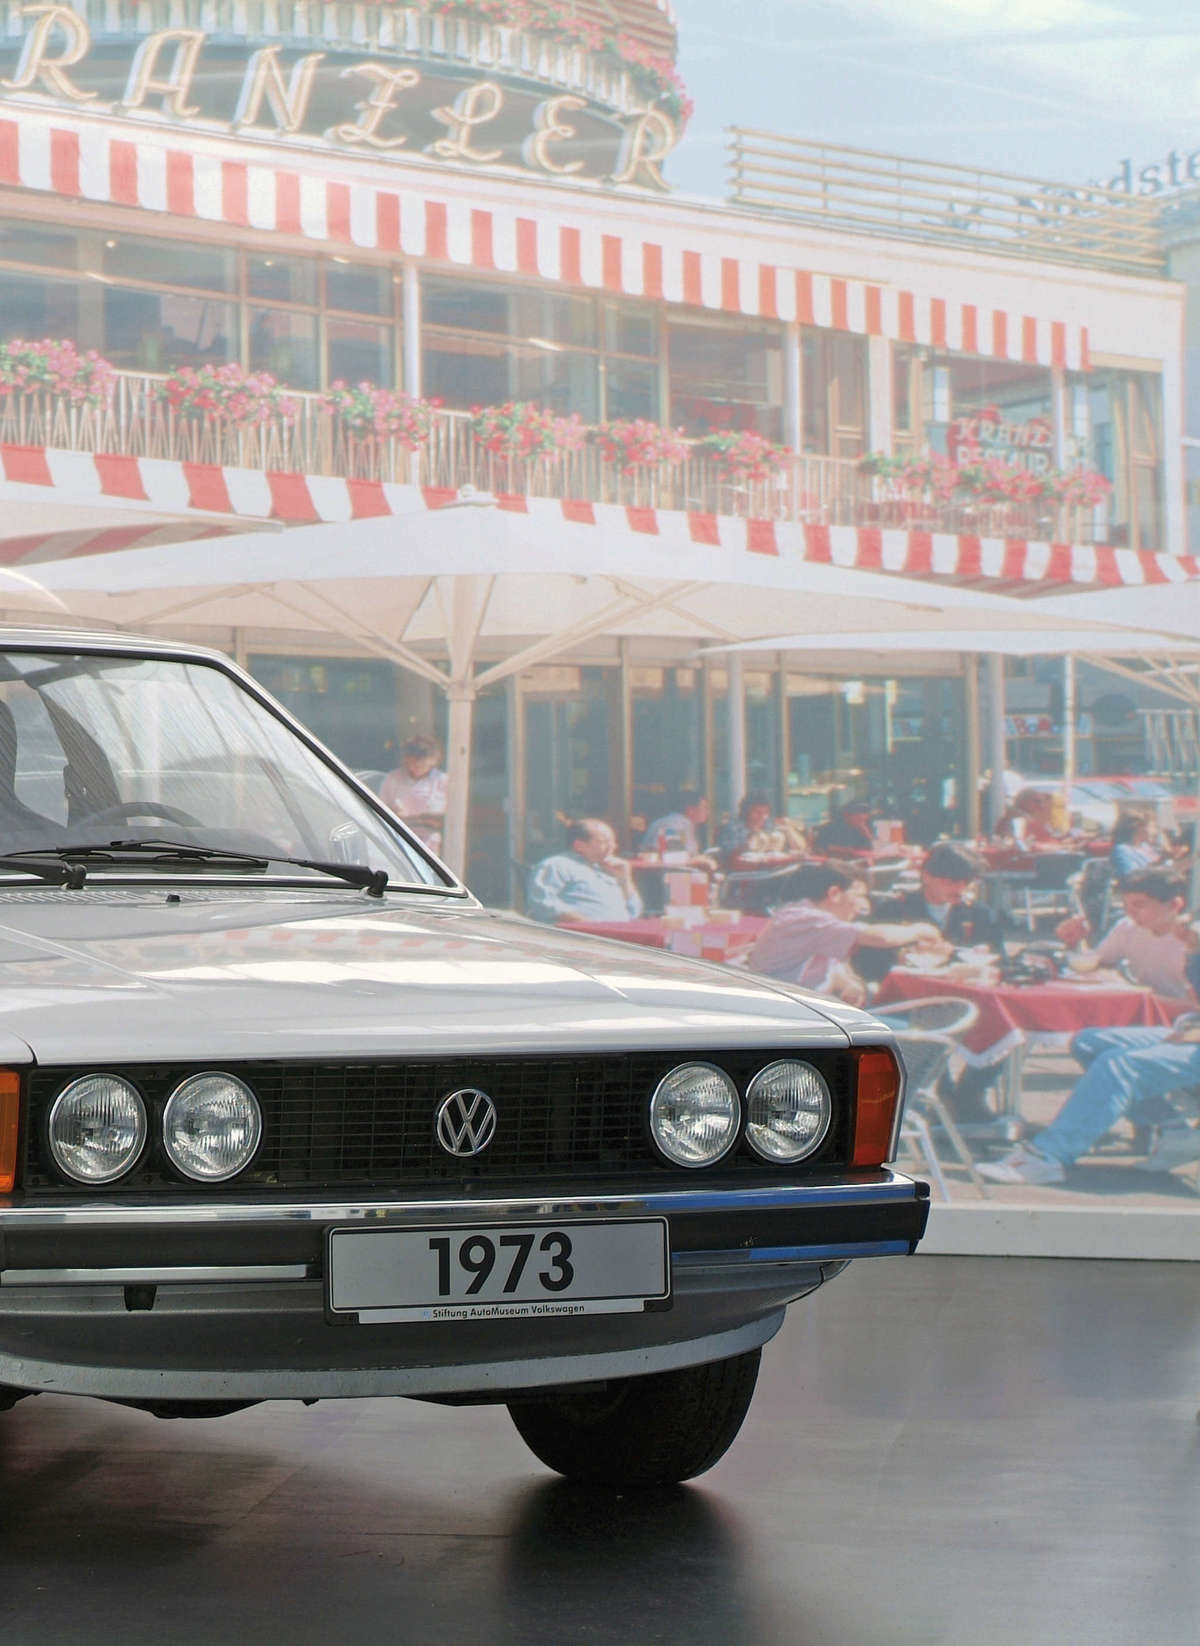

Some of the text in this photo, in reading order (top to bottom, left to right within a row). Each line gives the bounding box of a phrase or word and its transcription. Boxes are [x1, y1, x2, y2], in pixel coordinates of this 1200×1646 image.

[437, 1088, 497, 1157] VW
[429, 1231, 574, 1296] 1973
[433, 1303, 585, 1319] Stiftung AutoMuseum Volkswagen
